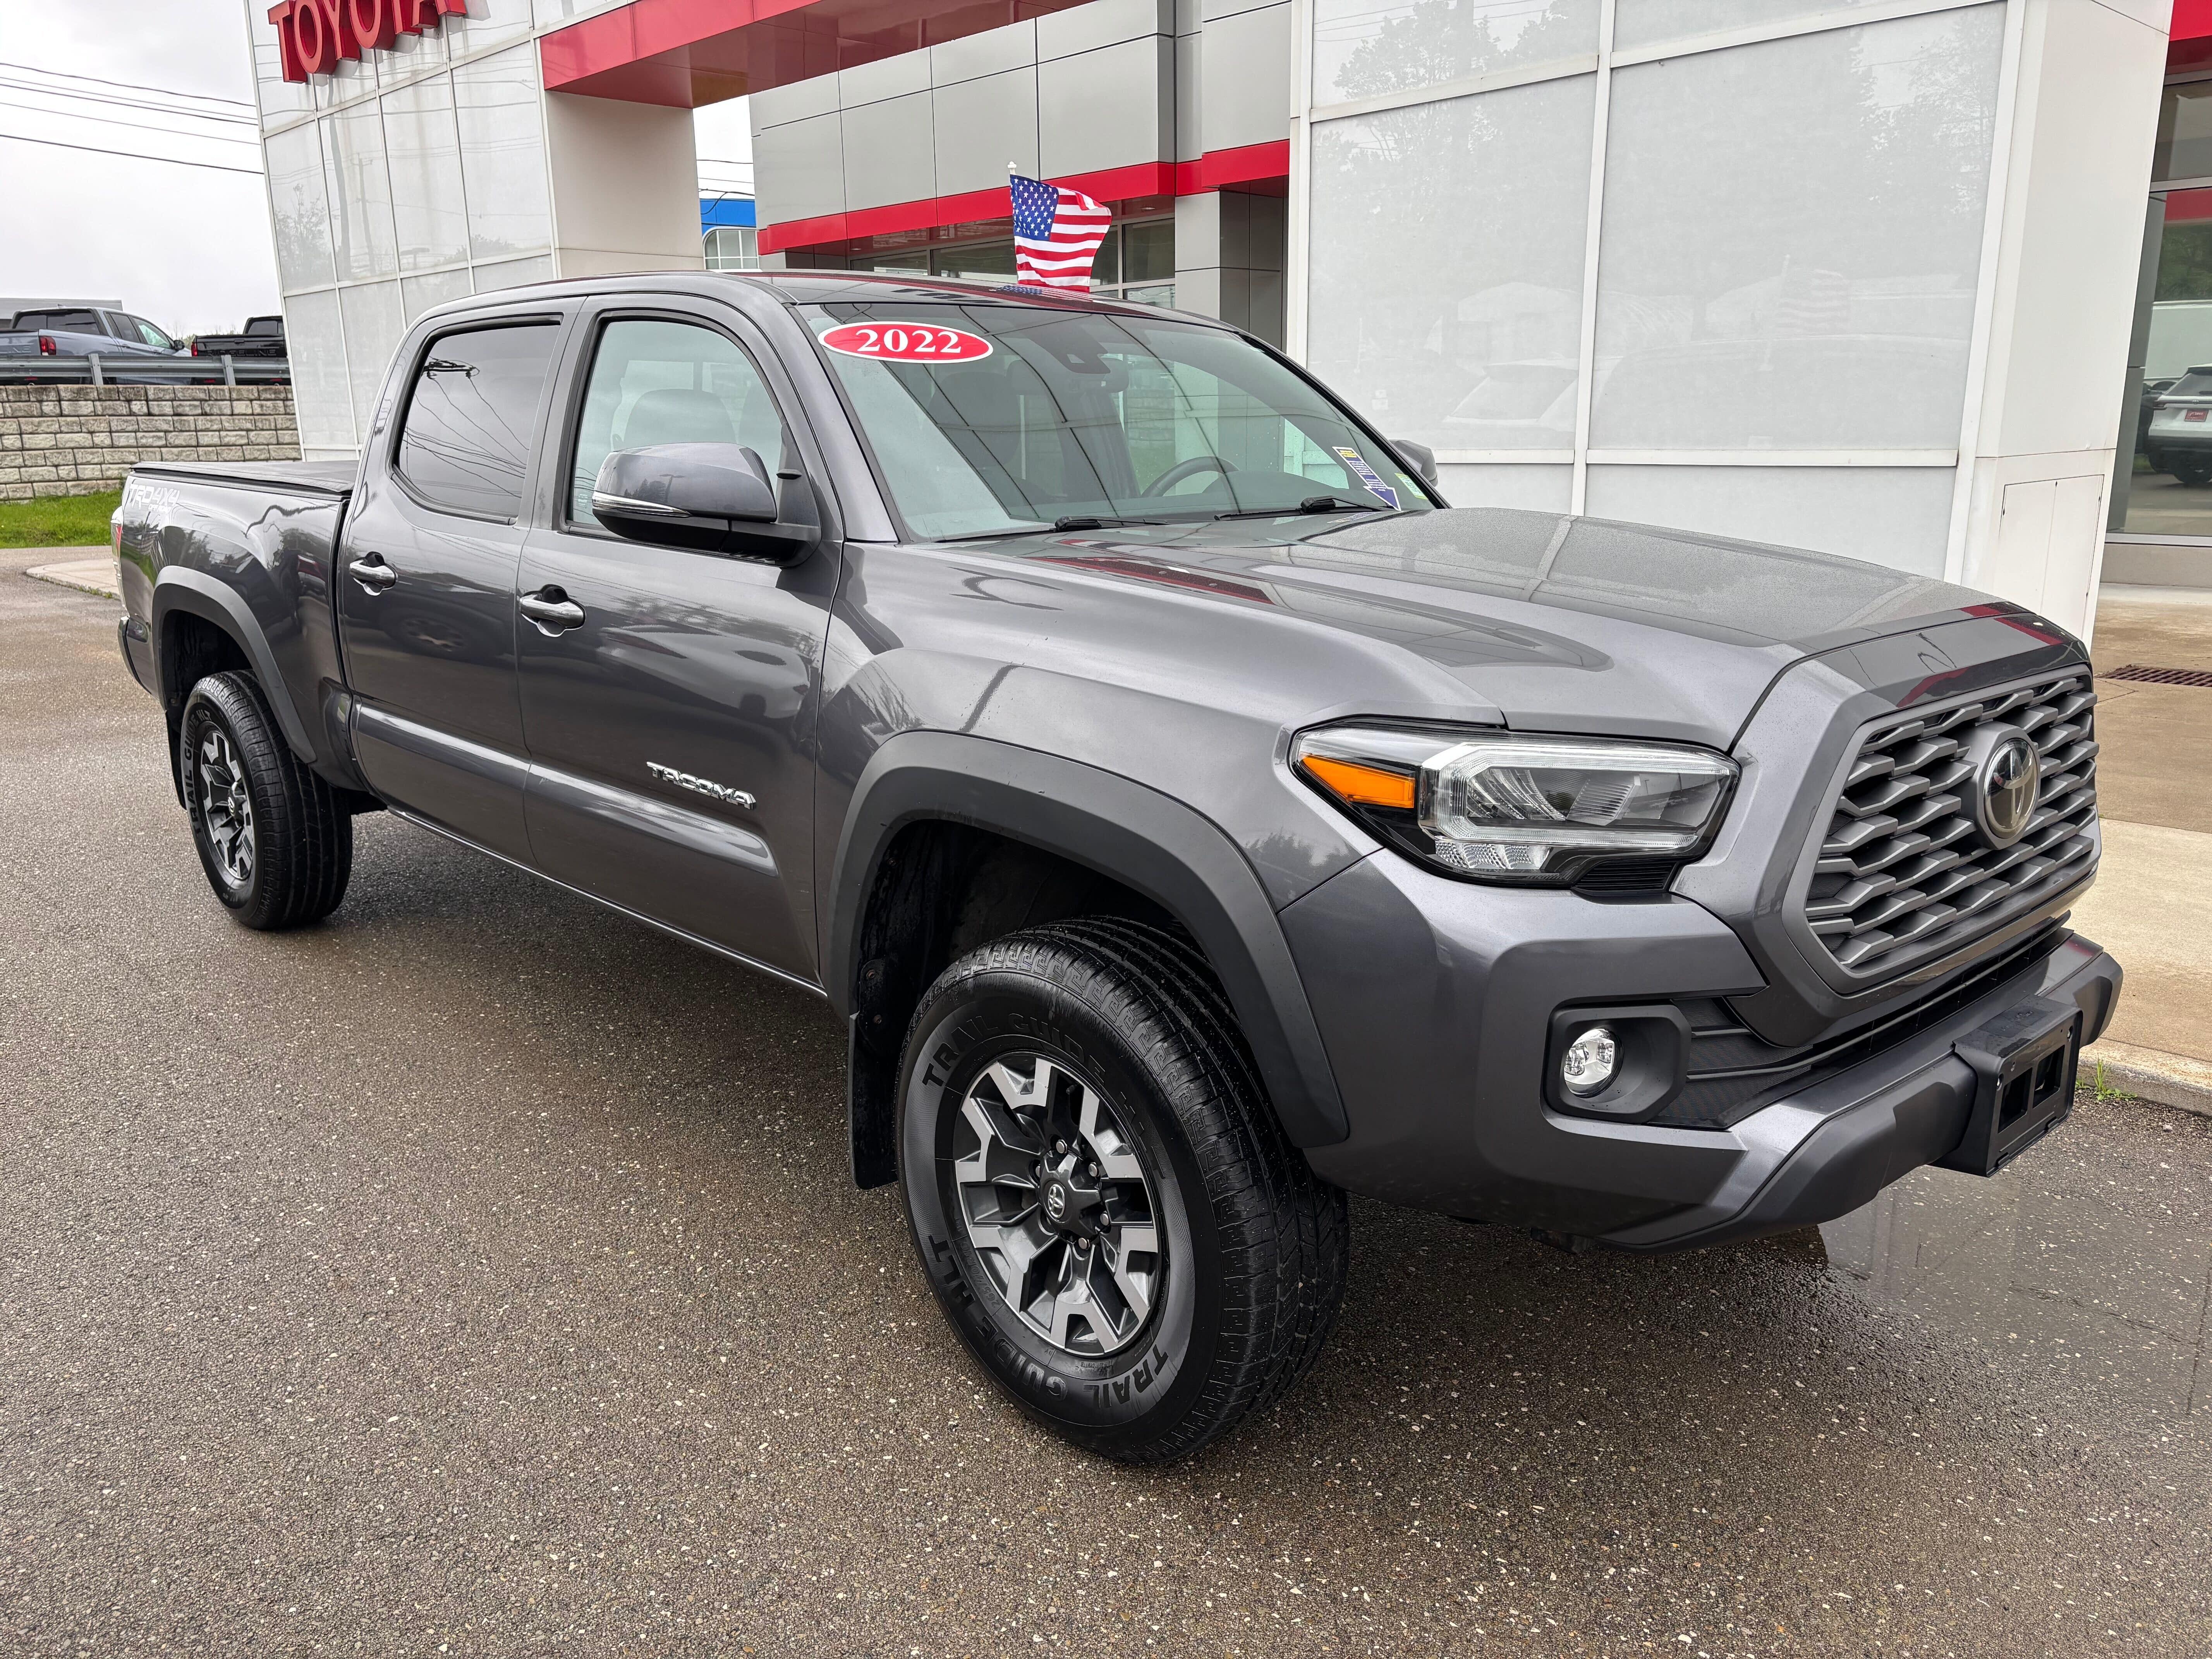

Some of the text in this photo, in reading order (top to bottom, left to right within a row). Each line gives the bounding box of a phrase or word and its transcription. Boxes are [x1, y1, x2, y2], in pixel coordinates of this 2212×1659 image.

[855, 329, 962, 353] 2022
[129, 484, 155, 510] TRD
[185, 713, 199, 760] GUIDE
[185, 770, 201, 838] TRAIL
[646, 761, 756, 810] TACOMA
[922, 1015, 999, 1087] TRAIL
[1008, 1013, 1106, 1085] GUIDE
[928, 1235, 1169, 1409] TRAIL GUIDE HLT
